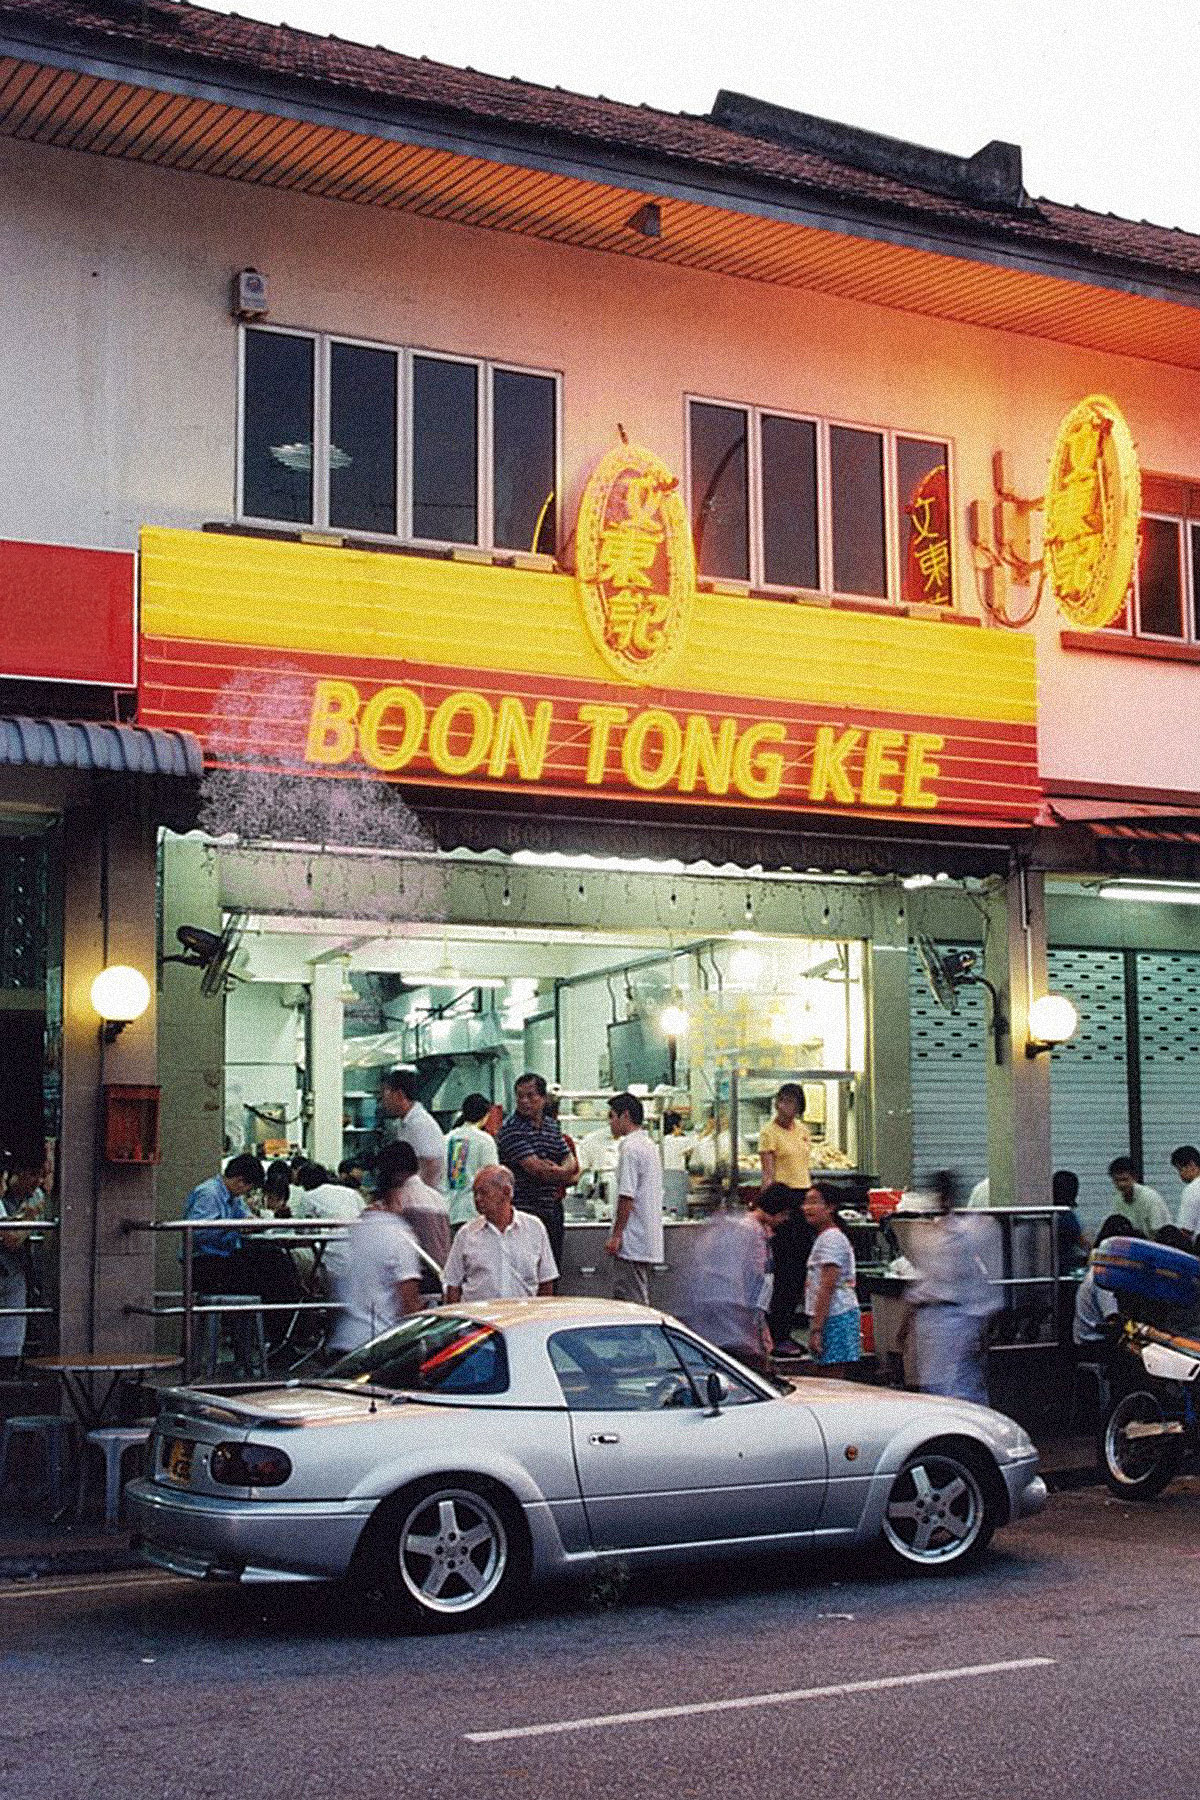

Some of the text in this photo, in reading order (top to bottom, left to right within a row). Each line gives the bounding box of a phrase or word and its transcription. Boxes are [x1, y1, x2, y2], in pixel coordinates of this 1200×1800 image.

[305, 679, 946, 809] BOON TONG KEE
